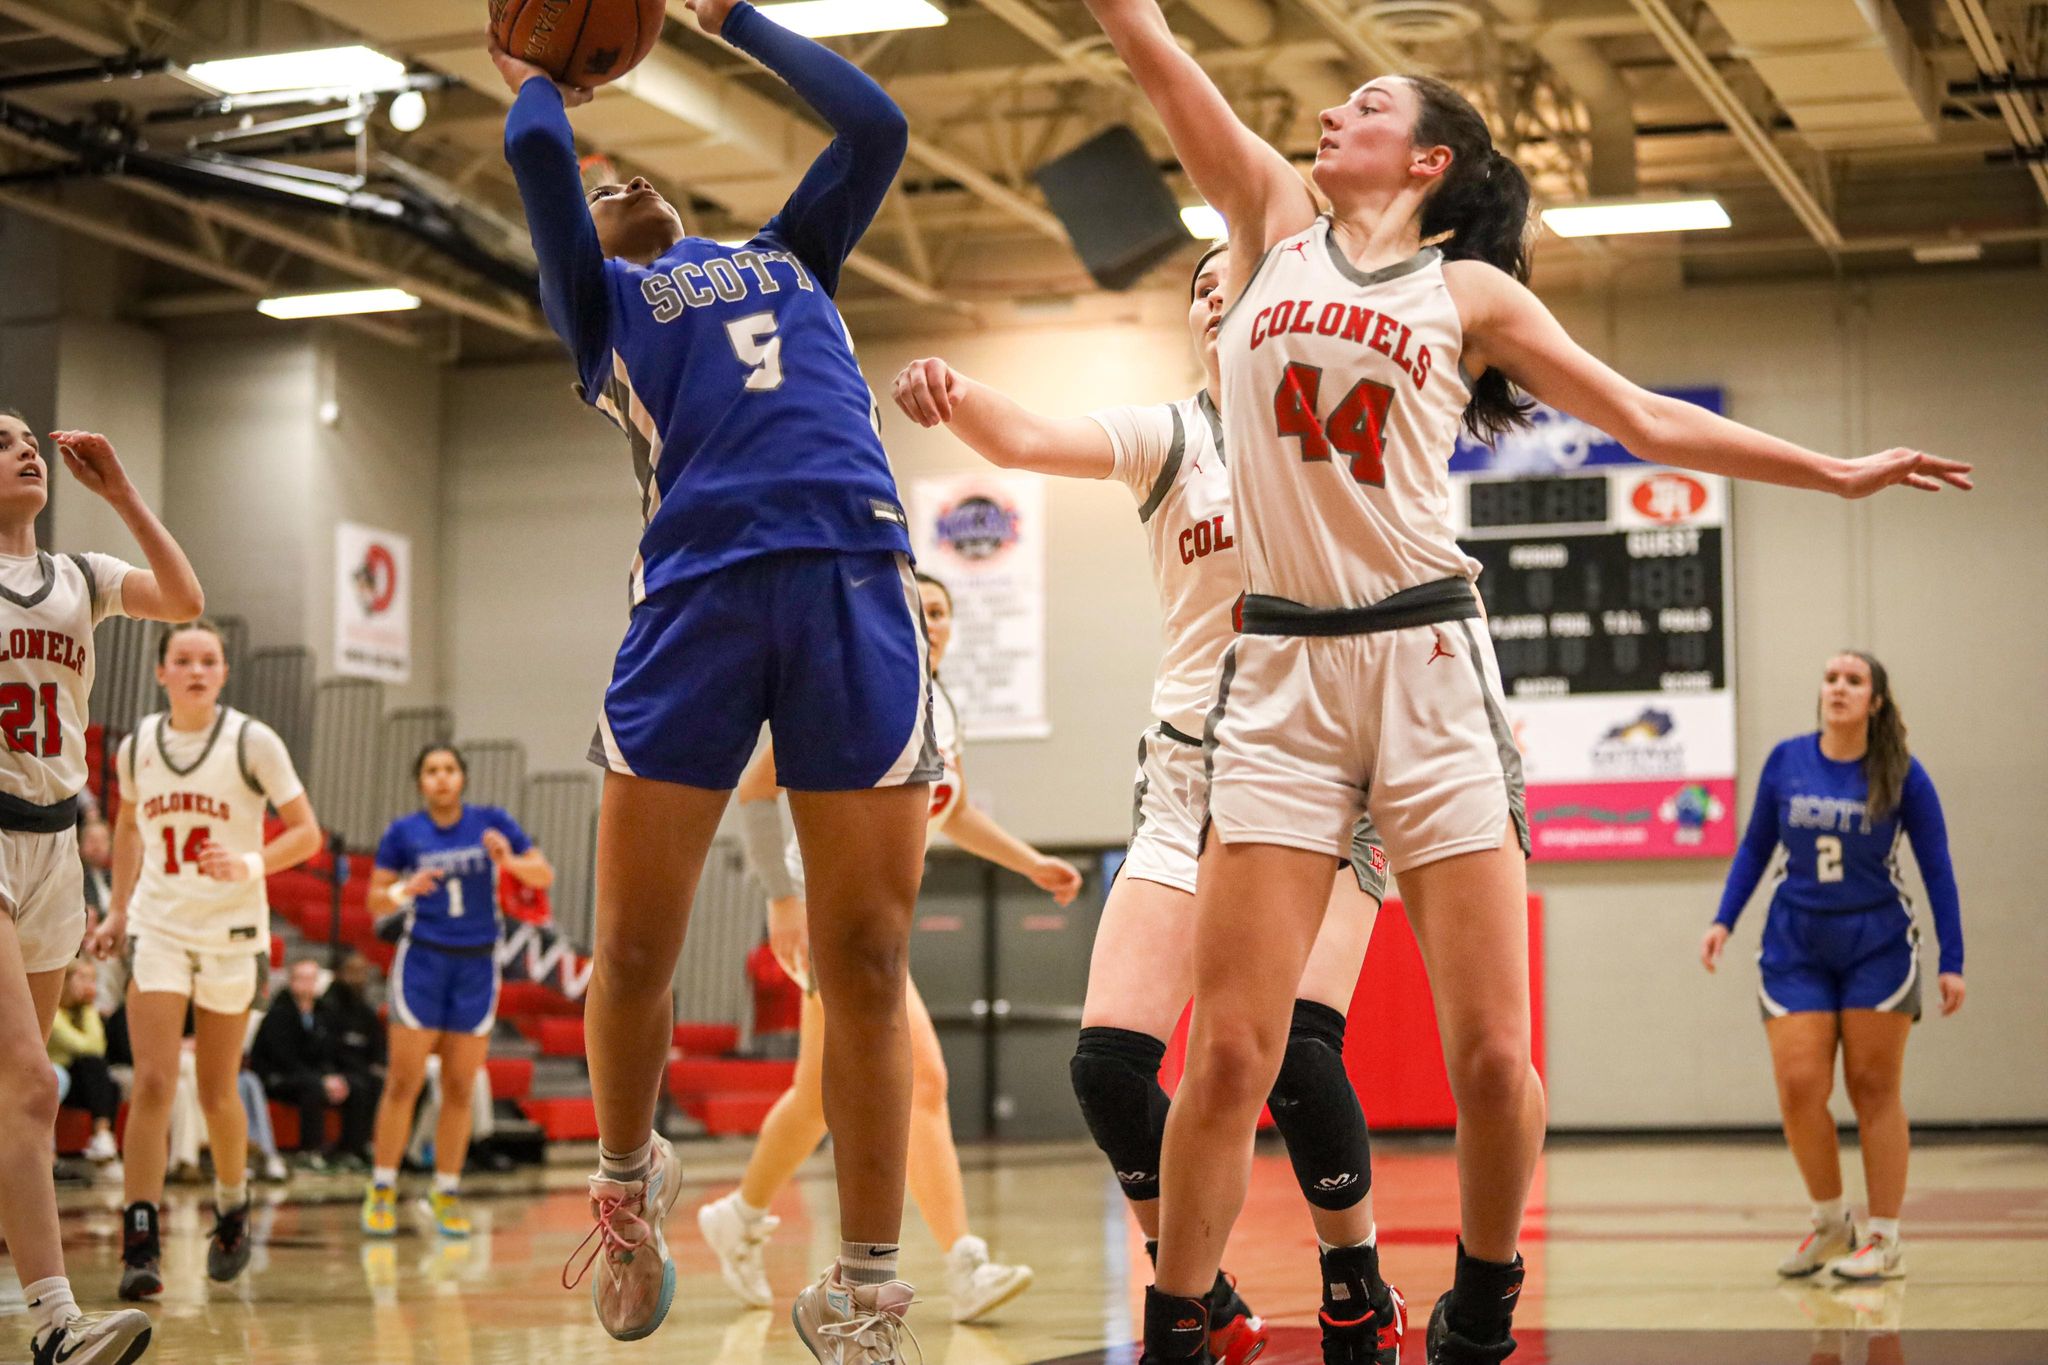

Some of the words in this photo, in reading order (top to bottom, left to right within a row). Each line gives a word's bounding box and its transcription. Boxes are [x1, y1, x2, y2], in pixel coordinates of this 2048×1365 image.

[641, 250, 813, 323] SCOTT
[723, 310, 784, 391] 5
[1250, 299, 1431, 390] COLONELS
[1274, 360, 1395, 489] 44
[1627, 531, 1700, 558] GUEST
[0, 682, 62, 758] 21
[143, 792, 230, 822] COLONELS
[1788, 794, 1871, 834] SCOTT
[162, 826, 211, 876] 14
[1815, 835, 1844, 883] 2
[447, 878, 465, 918] 1
